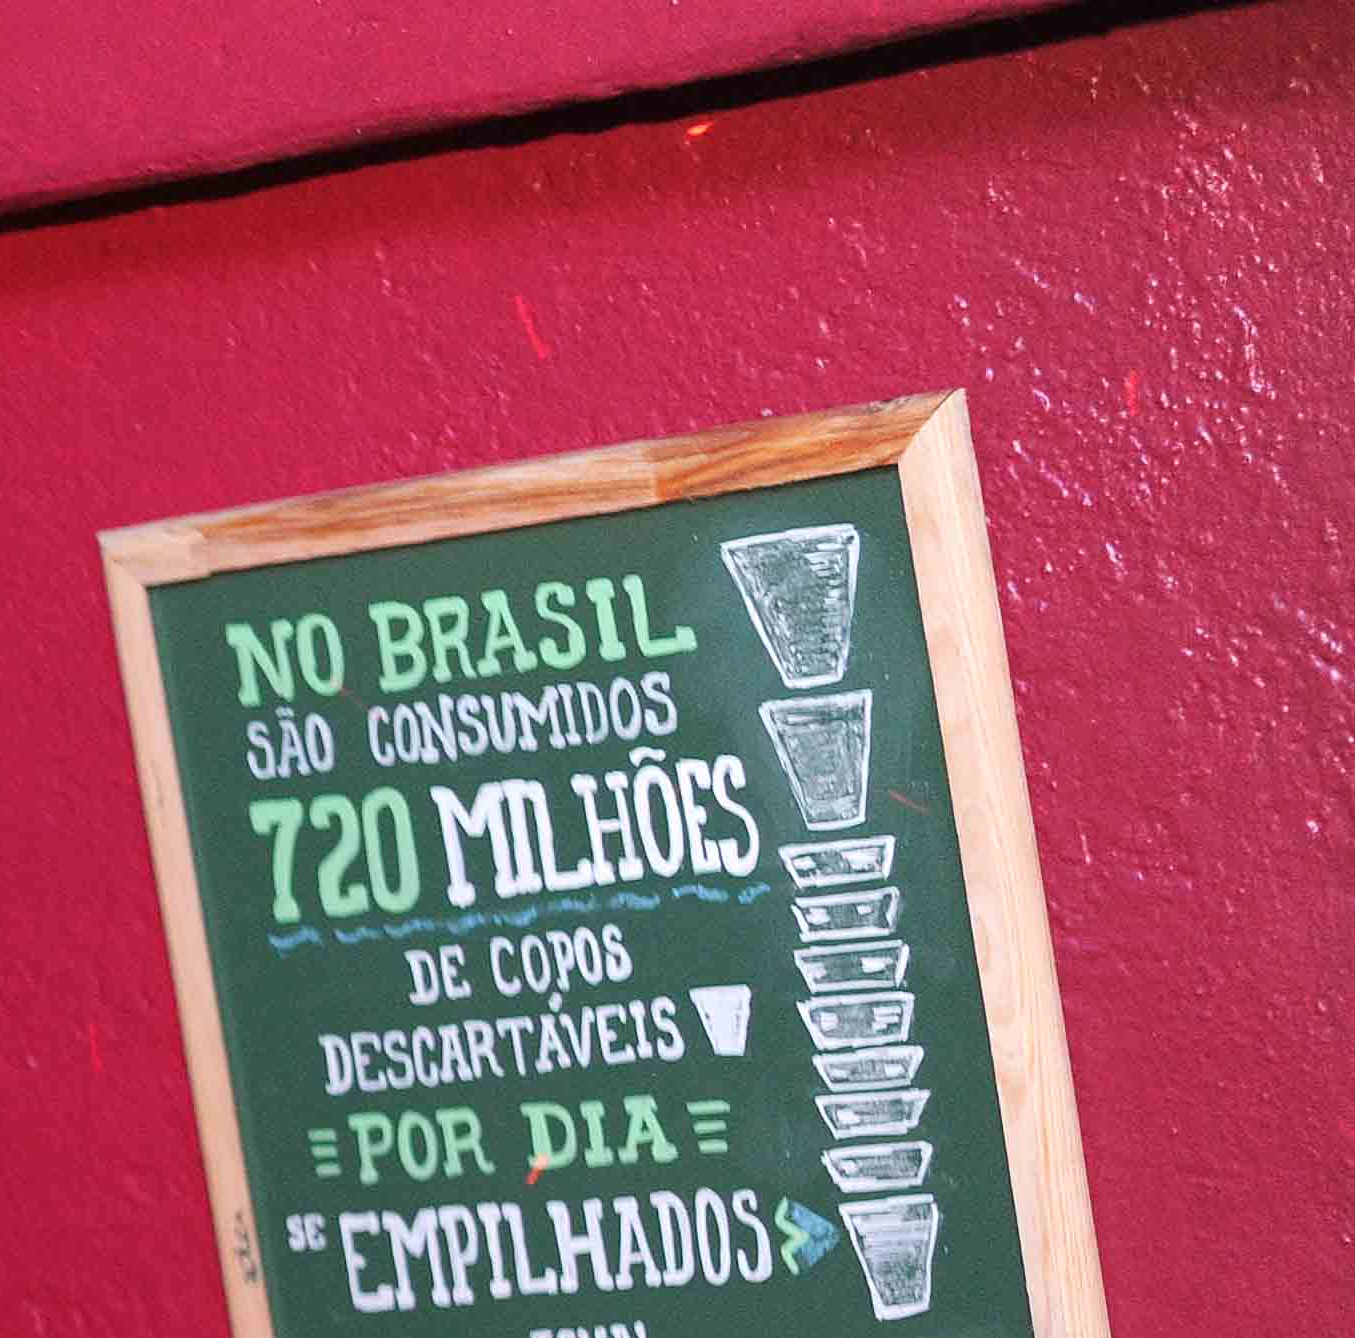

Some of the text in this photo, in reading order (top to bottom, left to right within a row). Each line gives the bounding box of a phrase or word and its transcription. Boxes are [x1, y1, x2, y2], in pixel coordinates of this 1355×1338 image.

[225, 573, 699, 708] NO BRASIL
[246, 670, 678, 781] SÃO CONSUMIDOS
[248, 747, 763, 925] 720 MILHÕES
[403, 922, 633, 1013] DE COPOS
[317, 991, 687, 1097] DESCARTÁVEIS
[347, 1093, 680, 1186] POR DIA
[286, 1186, 774, 1314] SE EMPILHADOS
